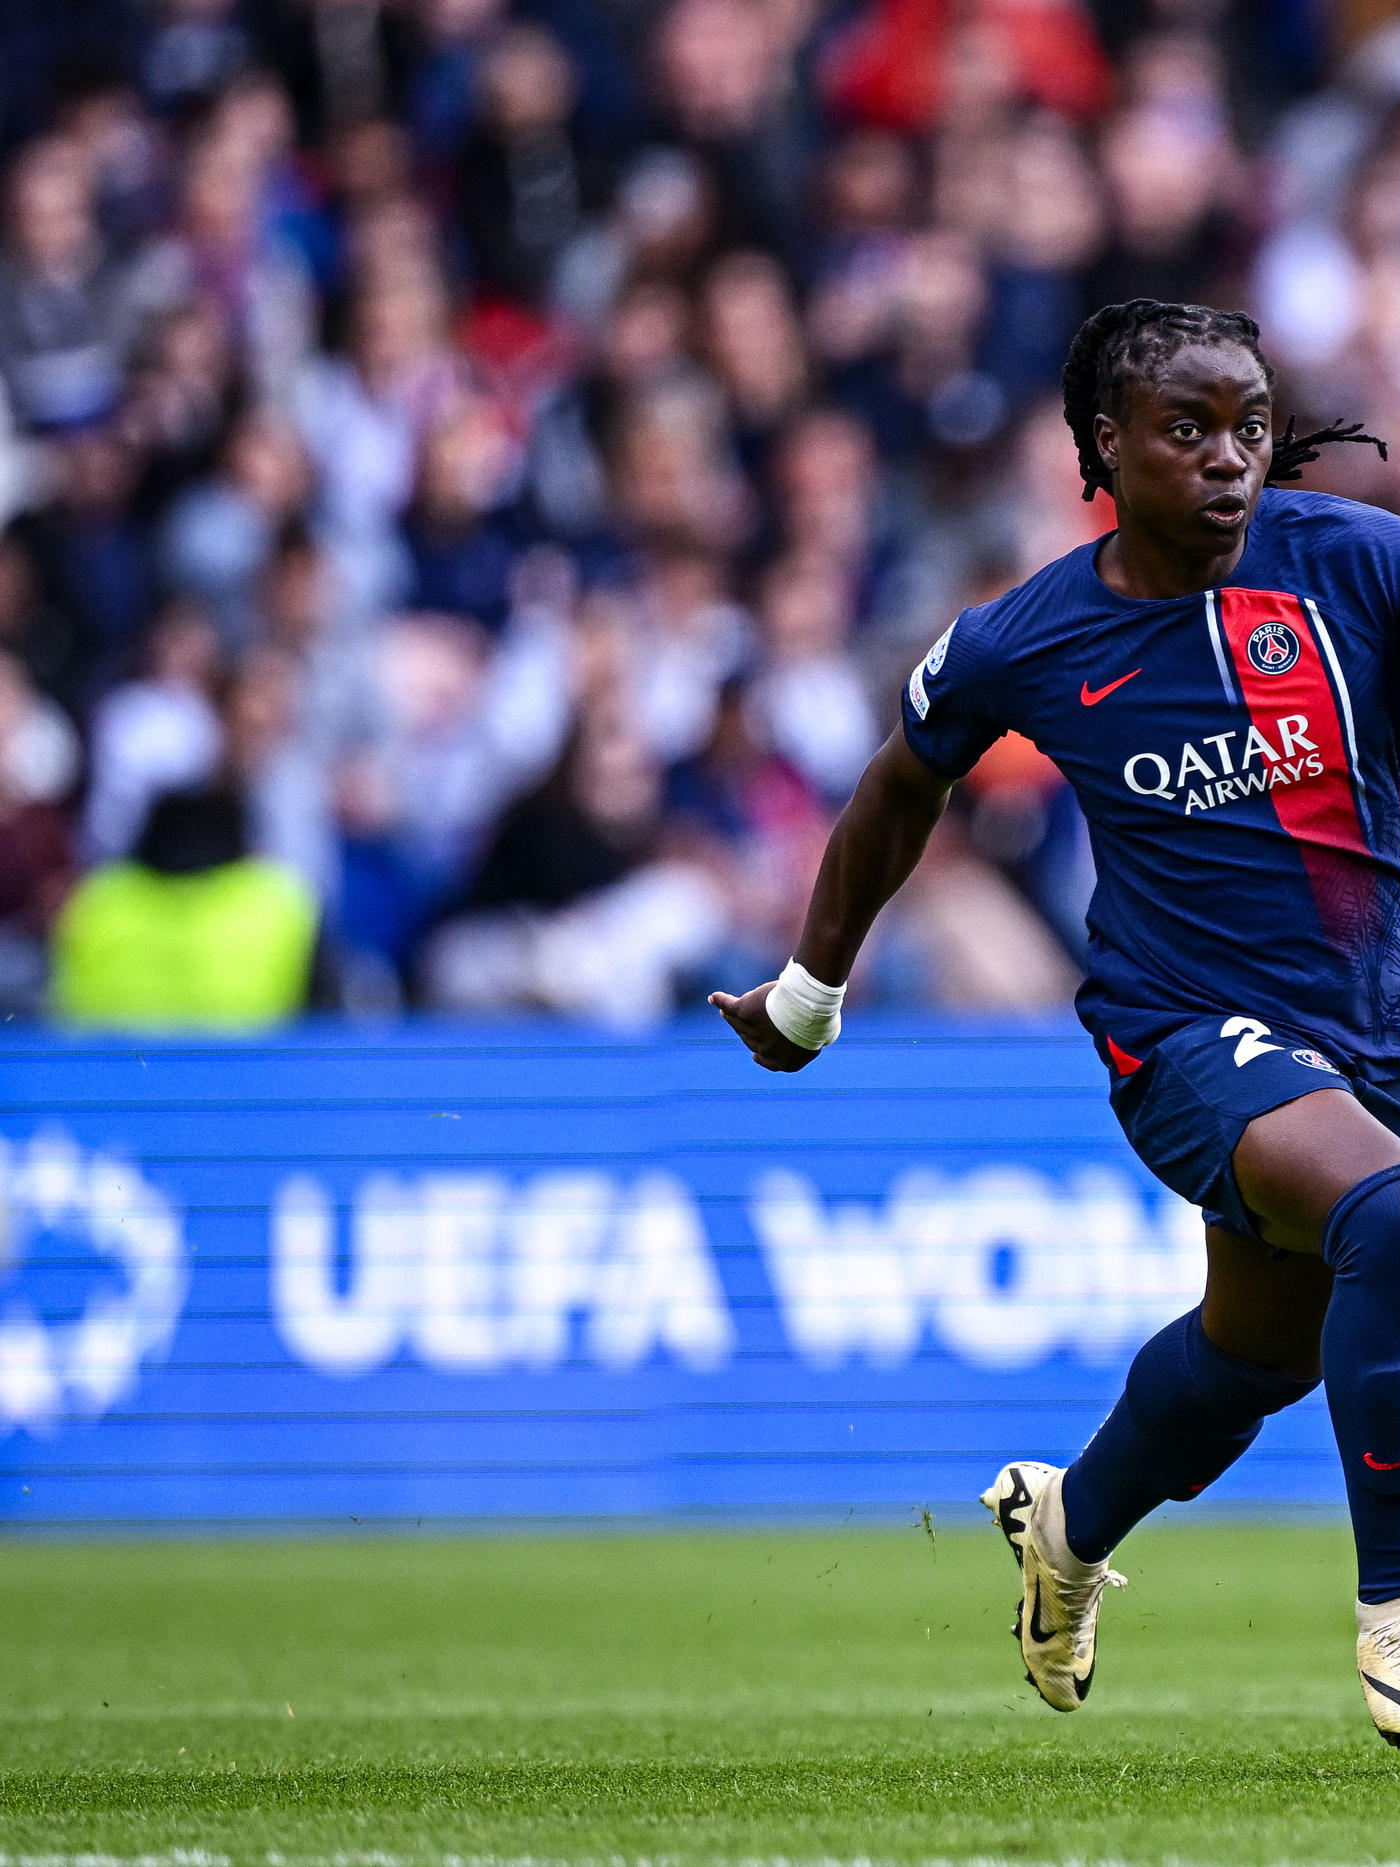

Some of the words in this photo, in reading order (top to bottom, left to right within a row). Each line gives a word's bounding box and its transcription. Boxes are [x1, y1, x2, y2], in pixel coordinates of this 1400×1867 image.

[1252, 625, 1285, 643] PARIS
[1123, 714, 1319, 800] QATAR
[1185, 753, 1325, 815] AIRWAYS
[1220, 1016, 1285, 1068] 2
[272, 1170, 735, 1376] UEFA
